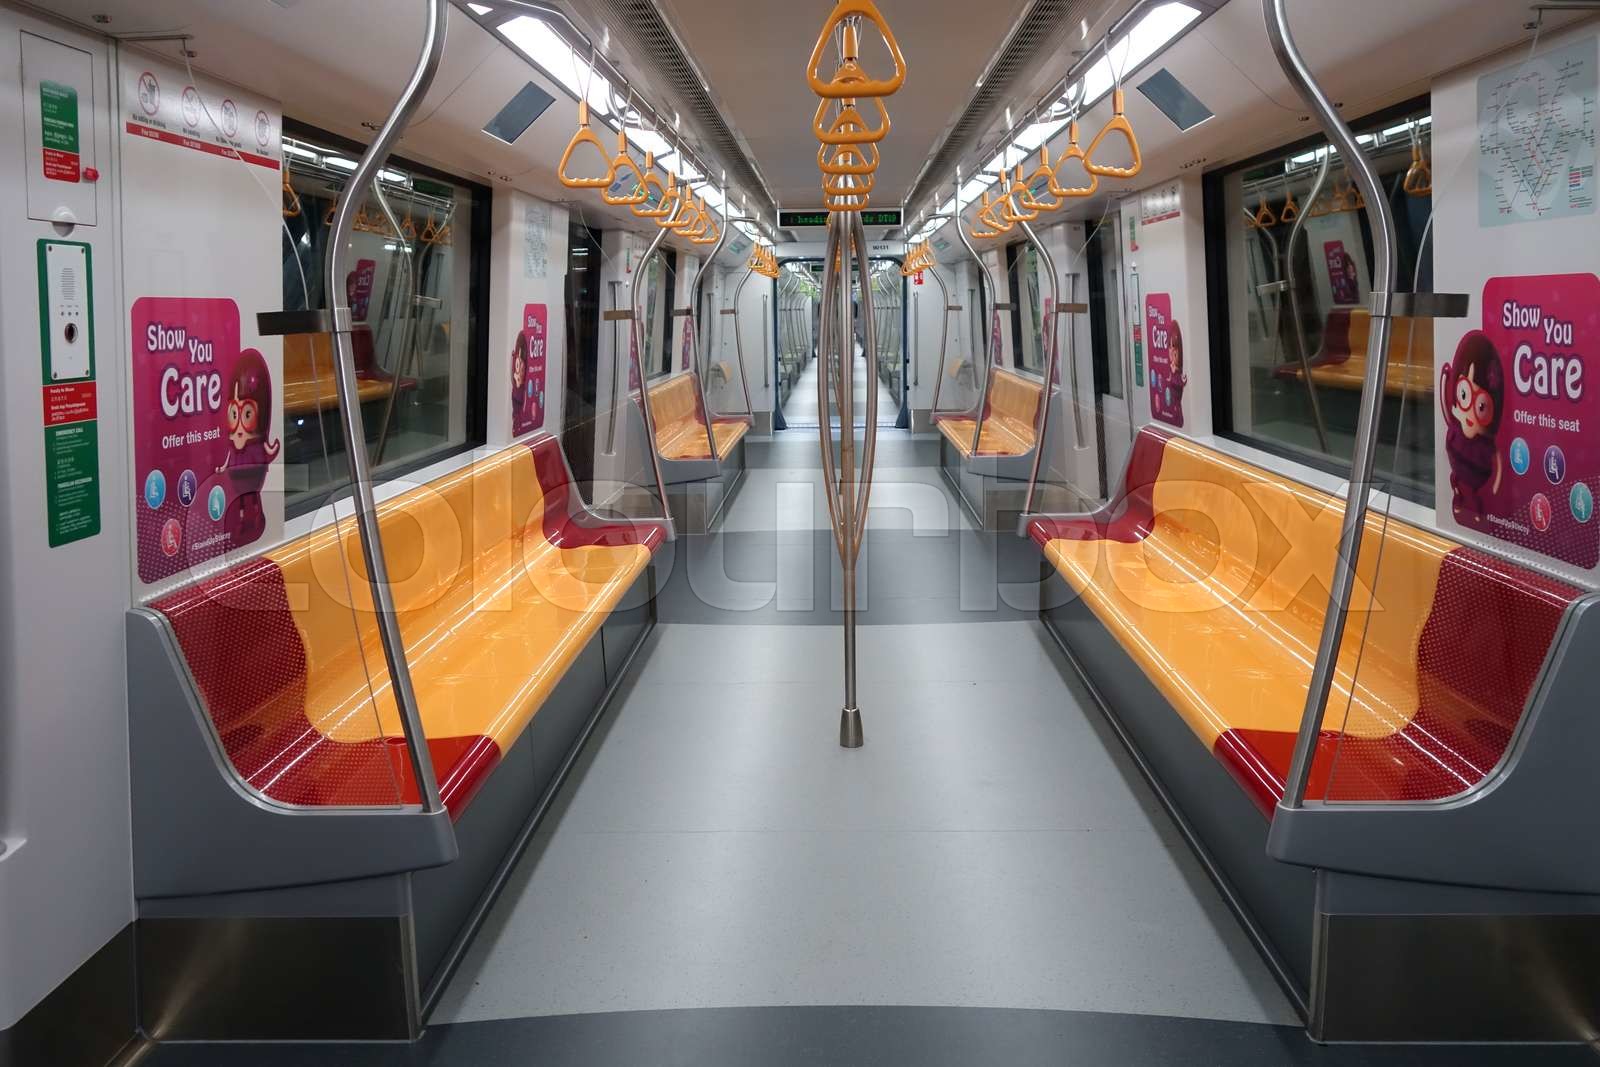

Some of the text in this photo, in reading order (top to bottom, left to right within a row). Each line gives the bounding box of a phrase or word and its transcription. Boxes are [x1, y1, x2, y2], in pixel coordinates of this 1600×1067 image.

[1153, 325, 1168, 349] Care
[1503, 302, 1572, 345] Show You
[147, 324, 213, 363] Show You
[530, 335, 543, 358] Care
[1513, 344, 1582, 399] Care
[160, 367, 221, 417] Care
[1513, 409, 1580, 433] Offer this seat
[162, 426, 221, 449] Offer this seat
